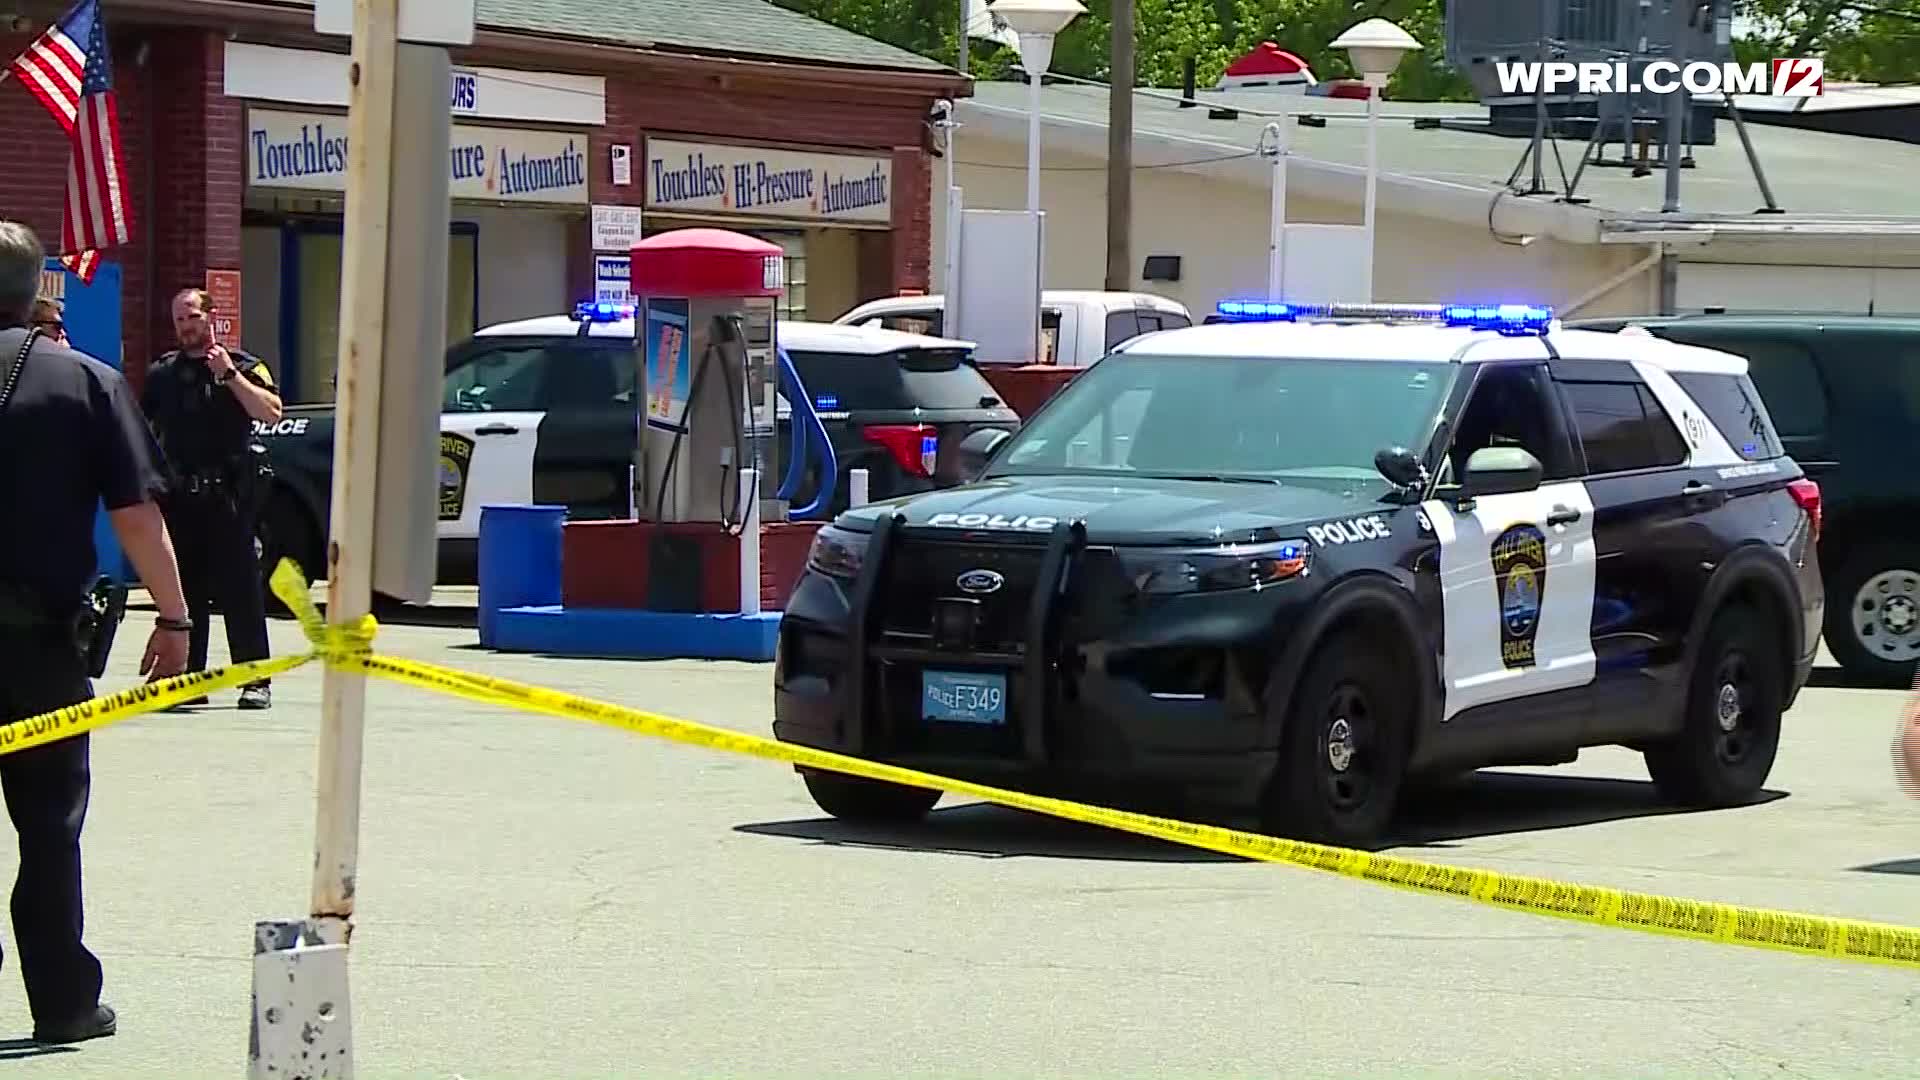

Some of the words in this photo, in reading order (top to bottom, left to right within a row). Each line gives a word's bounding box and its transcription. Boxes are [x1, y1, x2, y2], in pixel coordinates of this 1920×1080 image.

[452, 76, 475, 109] URS
[452, 144, 484, 179] ure
[499, 138, 584, 195] Automatic
[652, 153, 725, 203] Touchless
[733, 161, 813, 209] Hi-Pressure
[821, 162, 887, 213] Automatic
[42, 271, 63, 297] XIT
[216, 319, 231, 334] NO
[250, 418, 309, 435] OLICE
[928, 513, 1058, 530] POLIC
[1308, 516, 1391, 547] POLICE
[956, 686, 1000, 711] F349
